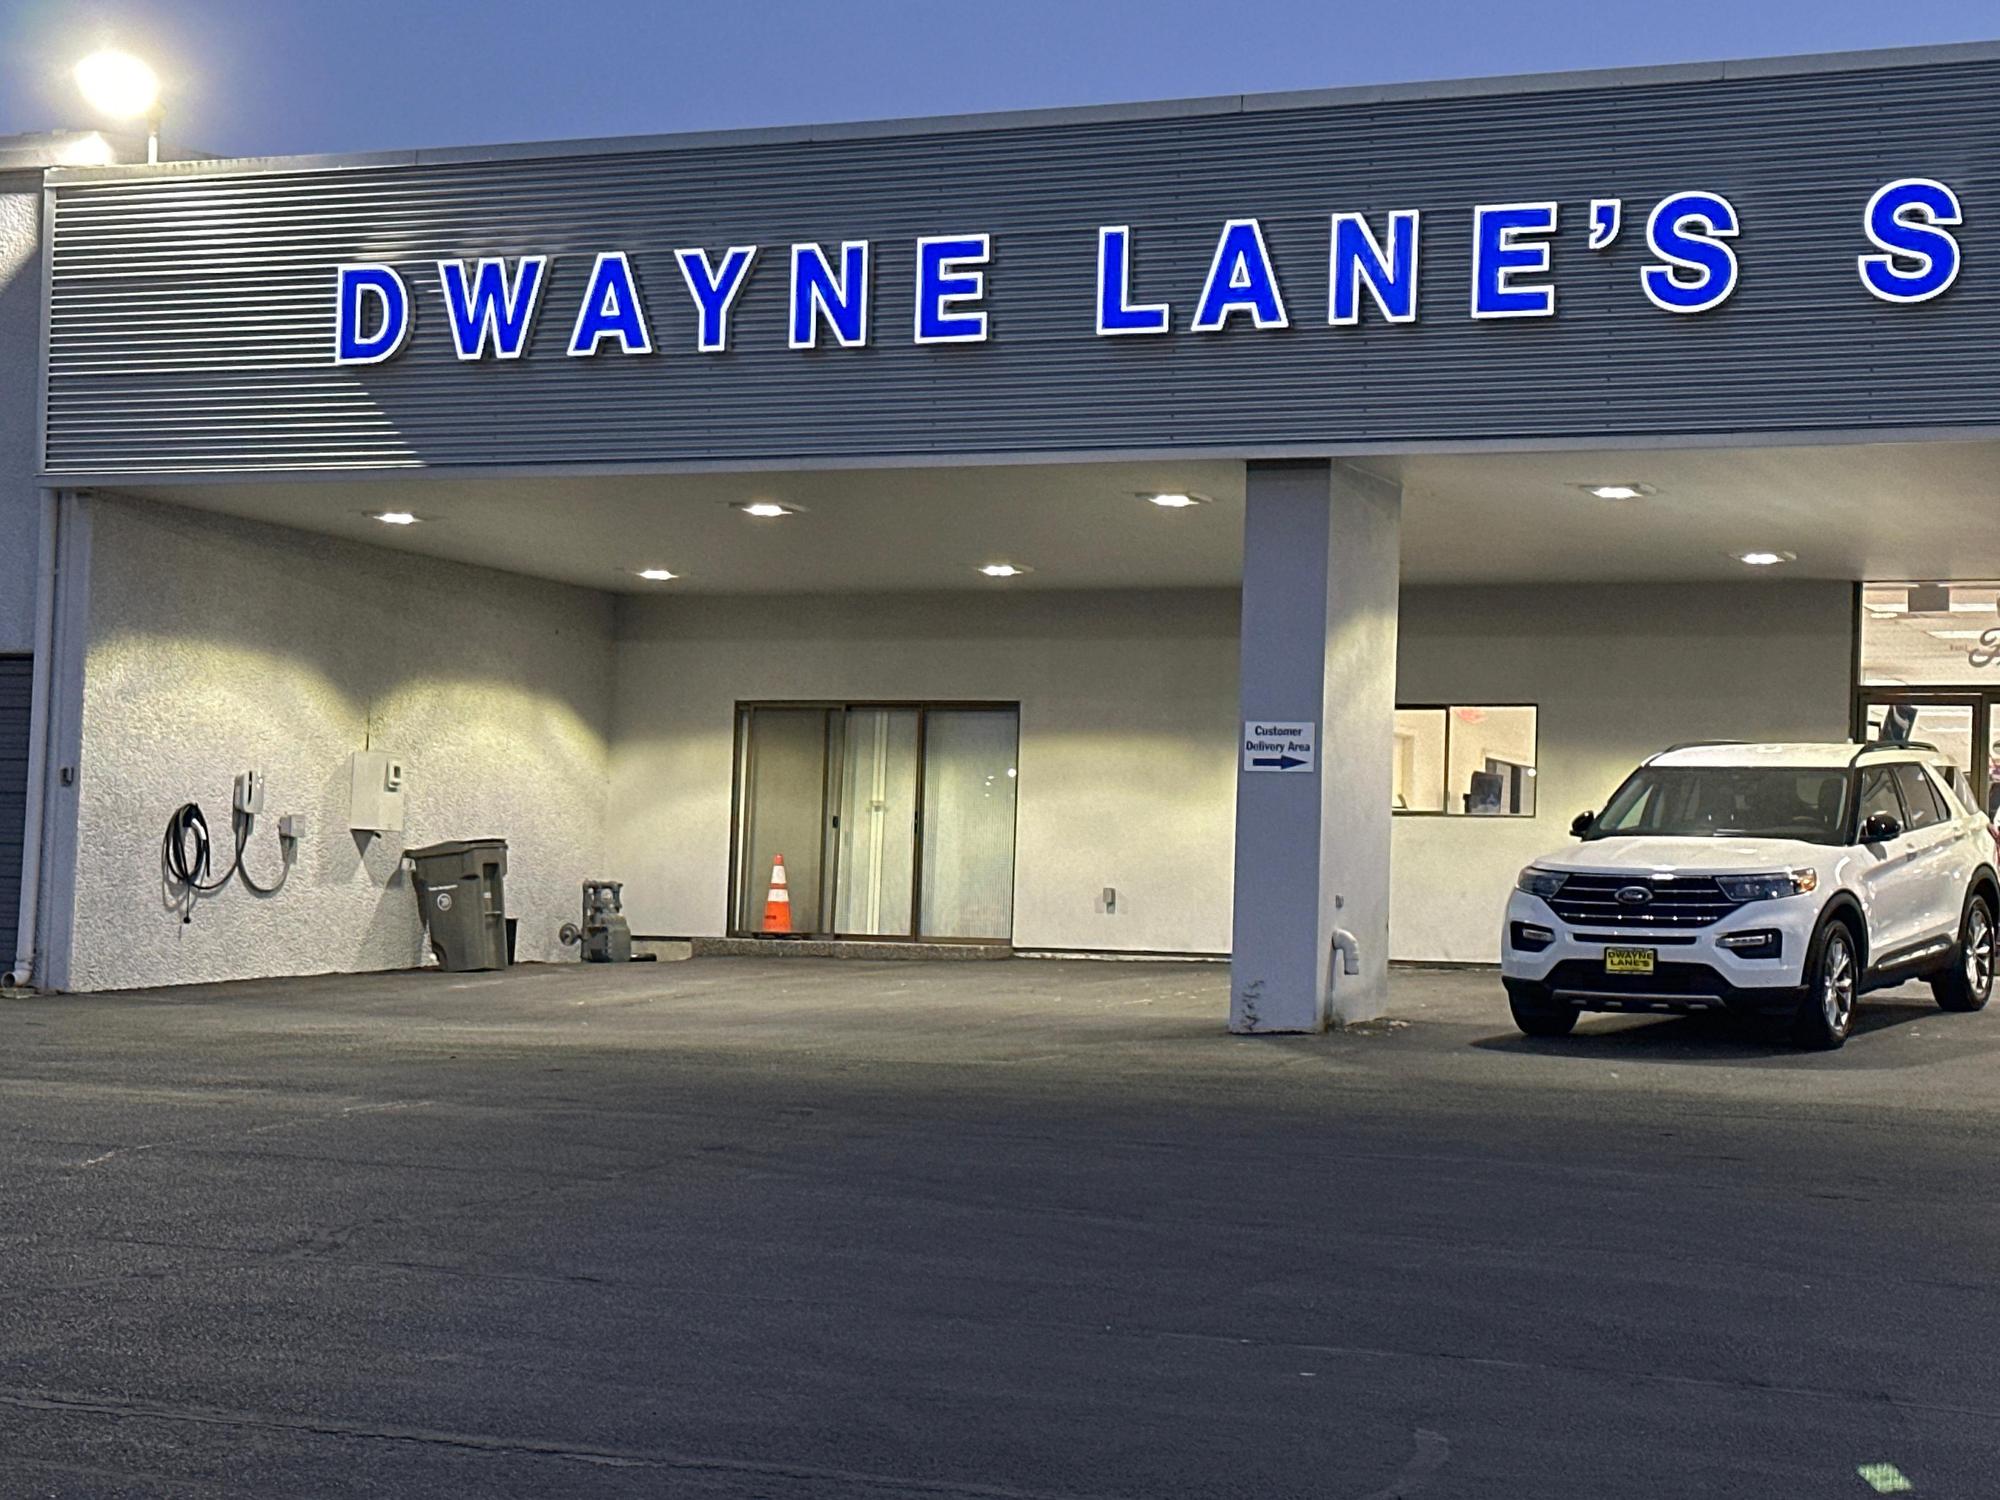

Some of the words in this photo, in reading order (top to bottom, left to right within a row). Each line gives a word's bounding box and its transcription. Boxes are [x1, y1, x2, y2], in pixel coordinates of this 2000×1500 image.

[335, 233, 990, 366] DWAYNE
[1096, 191, 1740, 337] LANE'S
[1255, 725, 1303, 736] Customer
[1246, 740, 1285, 753] Delivery
[1288, 741, 1311, 752] Area
[1608, 951, 1653, 960] DWAYNE
